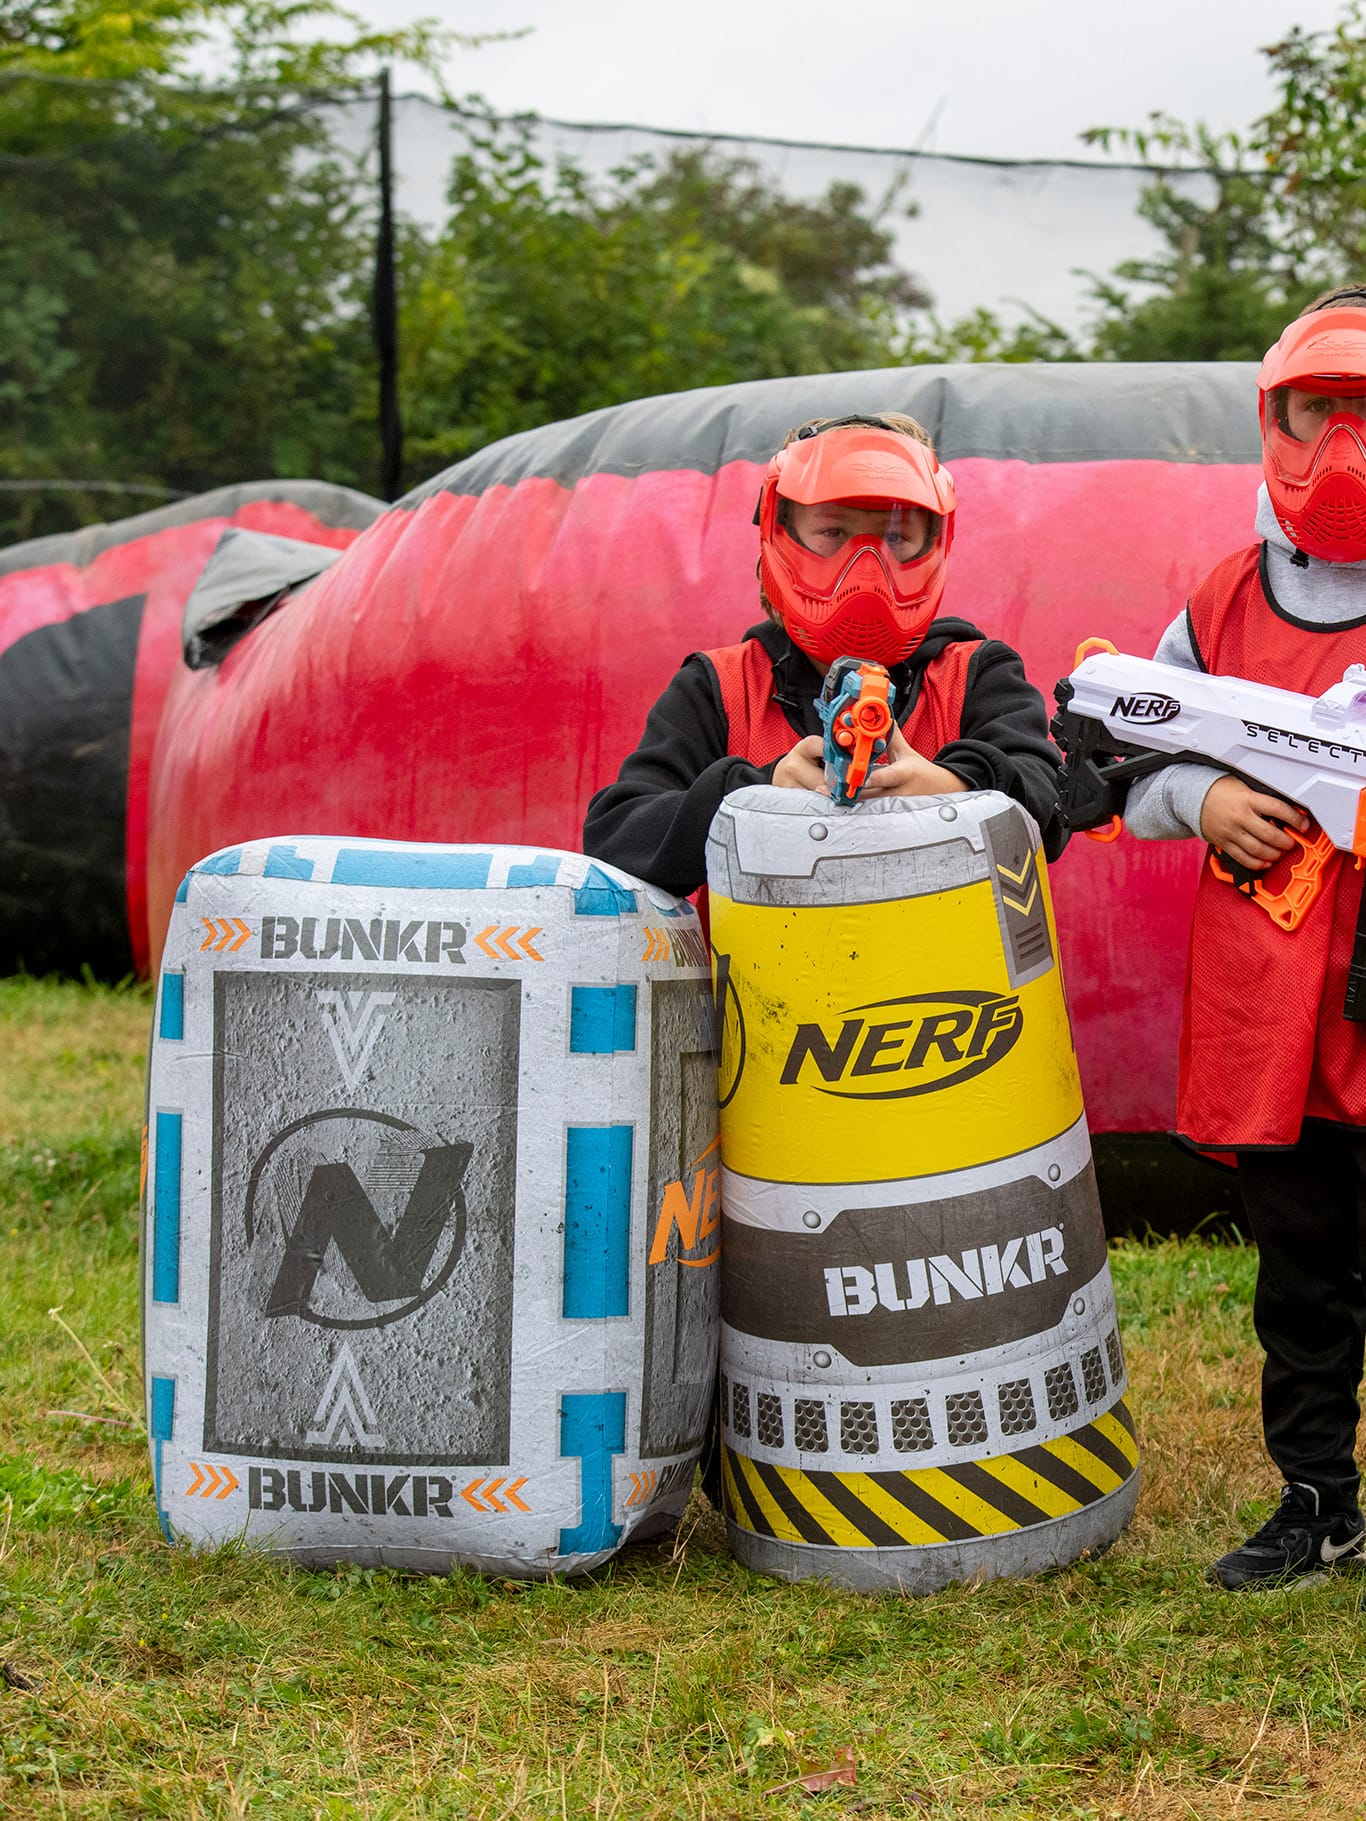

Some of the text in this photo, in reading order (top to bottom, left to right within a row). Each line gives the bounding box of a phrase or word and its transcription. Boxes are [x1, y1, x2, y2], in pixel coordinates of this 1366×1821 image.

[1110, 695, 1181, 718] NERF
[1247, 725, 1363, 763] SELECT
[261, 916, 467, 965] BUNKR
[780, 994, 1020, 1085] NERF
[823, 1226, 1069, 1317] BUNKR
[249, 1466, 454, 1518] BUNKR
